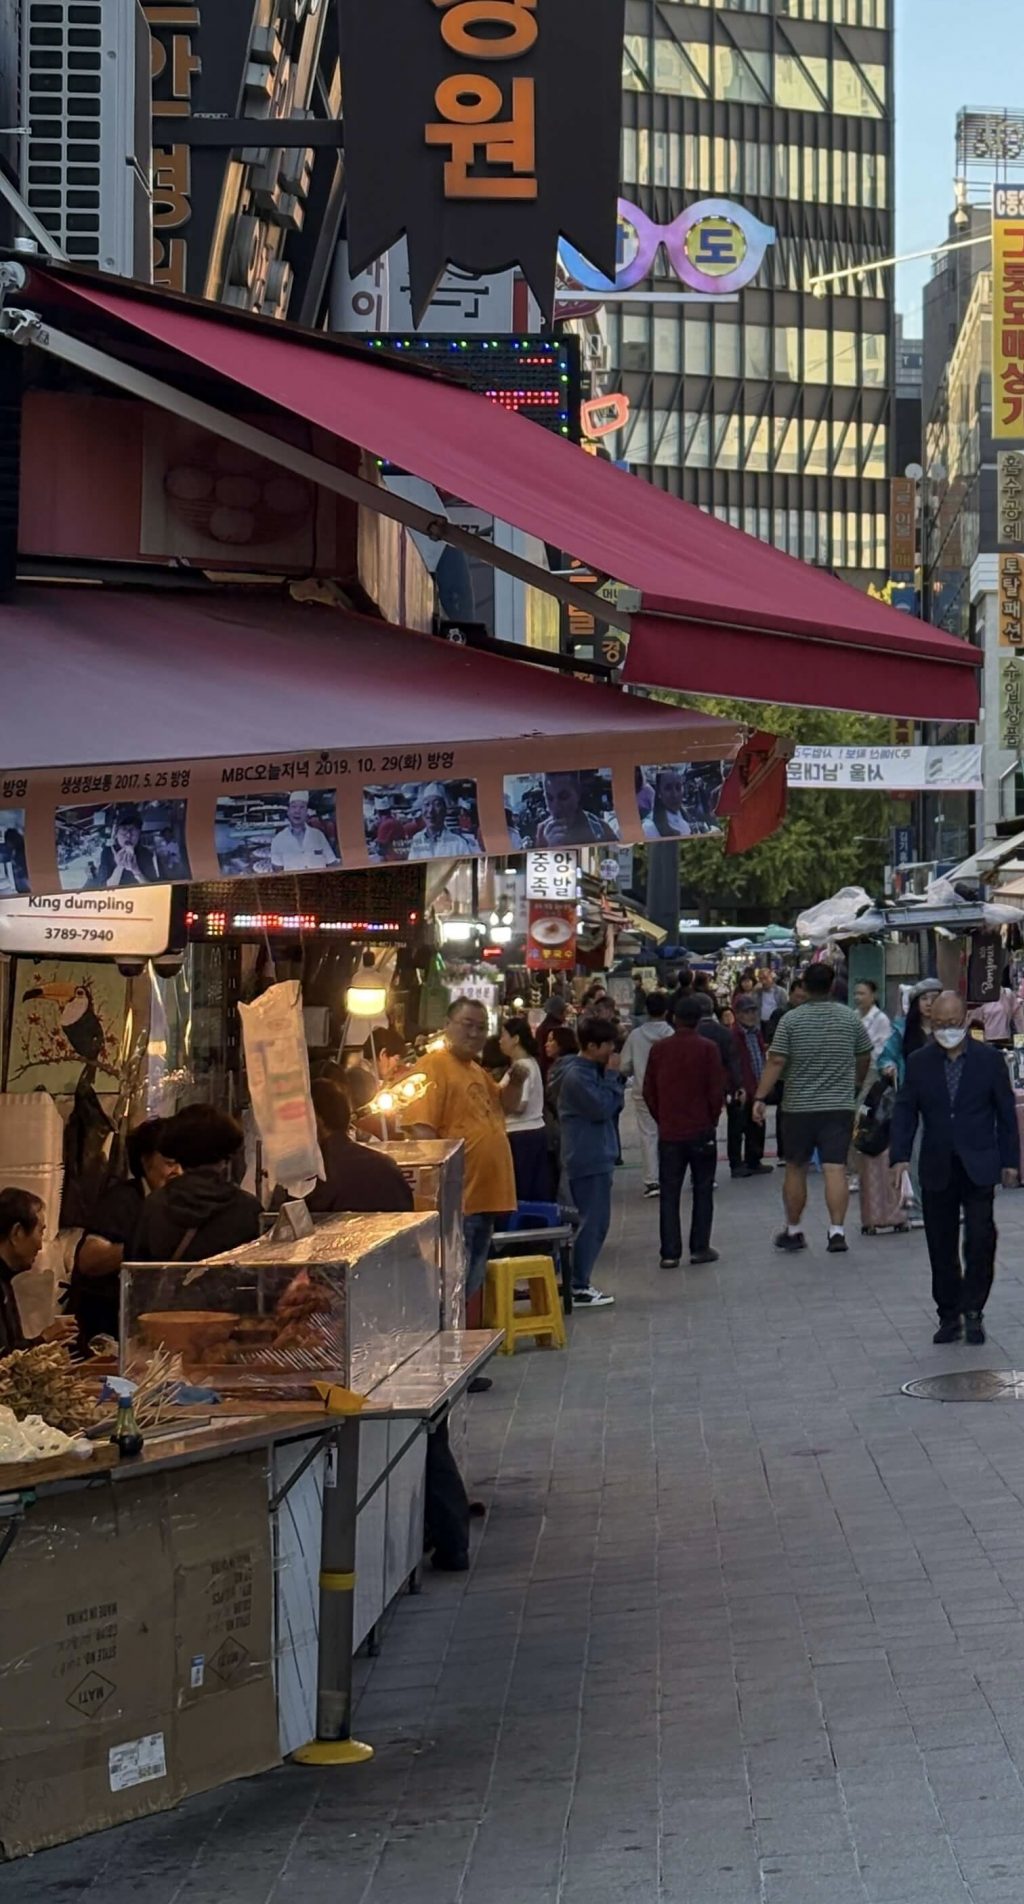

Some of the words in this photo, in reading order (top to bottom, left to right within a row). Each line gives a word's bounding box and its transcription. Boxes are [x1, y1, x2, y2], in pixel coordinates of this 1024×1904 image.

[1003, 558, 1021, 642] 토탈패션
[1003, 661, 1022, 745] 수입상품
[221, 763, 310, 783] MBC오늘저녁
[315, 759, 352, 776] 2019.
[358, 757, 377, 773] 10.
[427, 751, 455, 770] 방영
[3, 778, 28, 798] 방영
[61, 774, 113, 795] 생생정보통
[114, 774, 141, 790] 2017.
[155, 772, 168, 787] 25
[170, 769, 192, 788] 방영
[531, 852, 572, 873] 중앙
[530, 877, 572, 897] 족발
[28, 896, 61, 912] King
[64, 896, 135, 914] dumpling
[44, 928, 114, 942] 3789-7940
[78, 1685, 104, 1704] MATI
